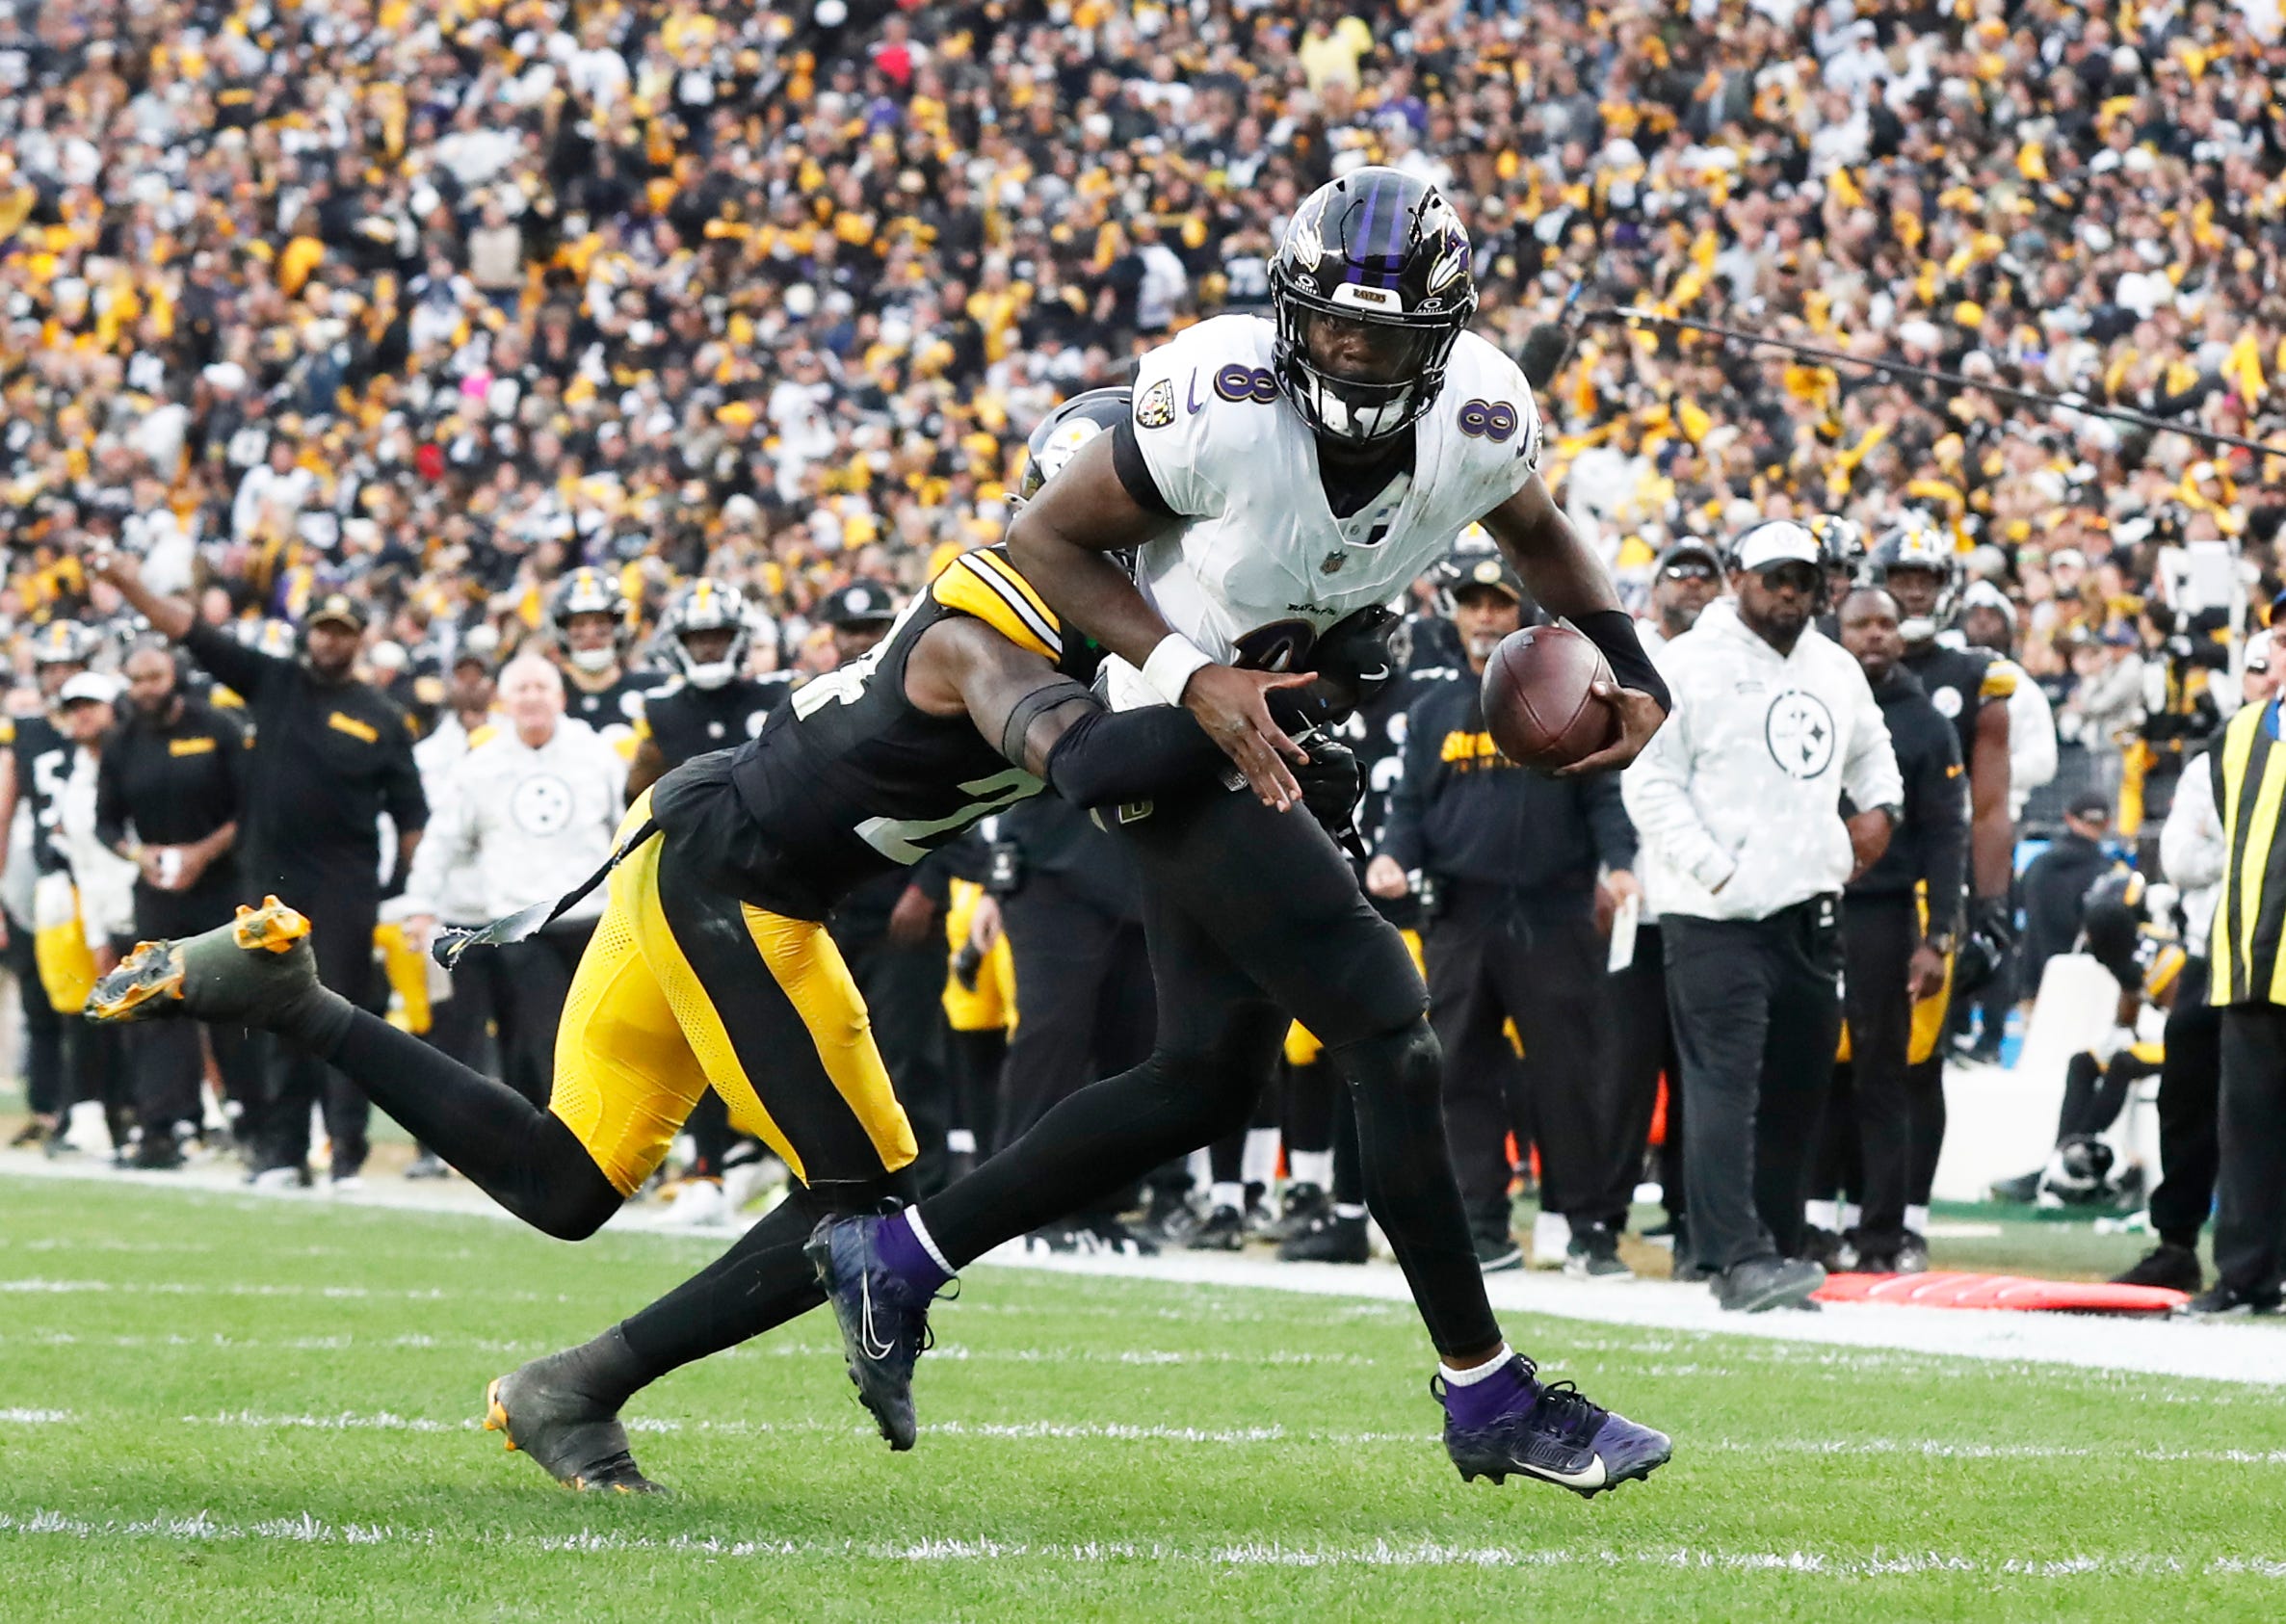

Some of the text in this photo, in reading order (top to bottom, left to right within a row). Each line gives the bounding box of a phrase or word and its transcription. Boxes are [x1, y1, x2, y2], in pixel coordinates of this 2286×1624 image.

[1213, 362, 1281, 405] 8
[1457, 398, 1518, 443] 8
[854, 767, 1047, 866] 2
